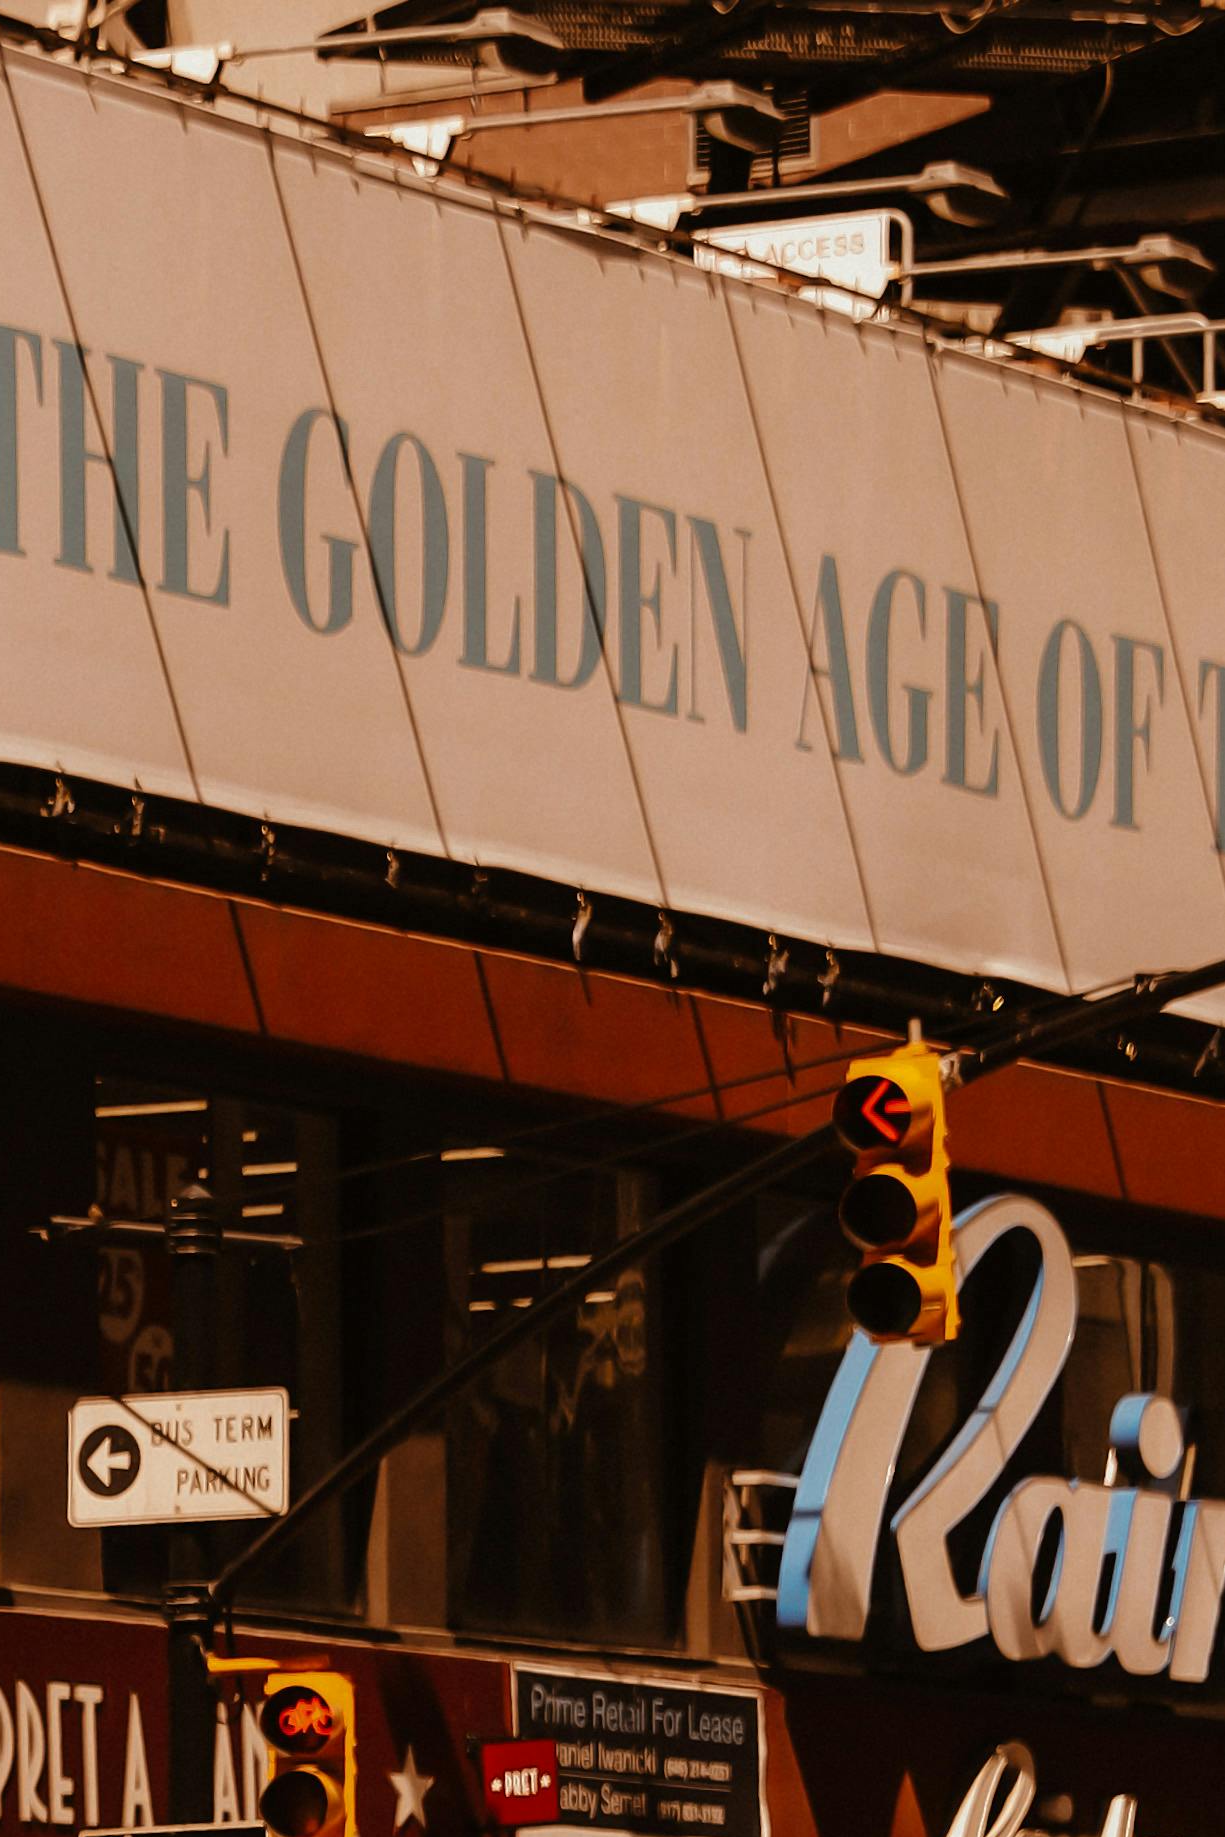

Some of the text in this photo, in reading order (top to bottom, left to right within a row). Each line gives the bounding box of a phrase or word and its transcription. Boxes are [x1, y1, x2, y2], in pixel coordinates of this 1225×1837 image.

[277, 407, 752, 734] GOLDEN
[795, 553, 1000, 798] AGE
[1037, 617, 1165, 832] OF
[150, 1414, 273, 1447] BUS TERM
[177, 1464, 270, 1497] PARKING
[530, 1683, 745, 1745] Prime Retail For Lease
[122, 1692, 155, 1827] A
[557, 1741, 594, 1769] aniel
[504, 1767, 538, 1797] PRET
[559, 1782, 597, 1818] abby
